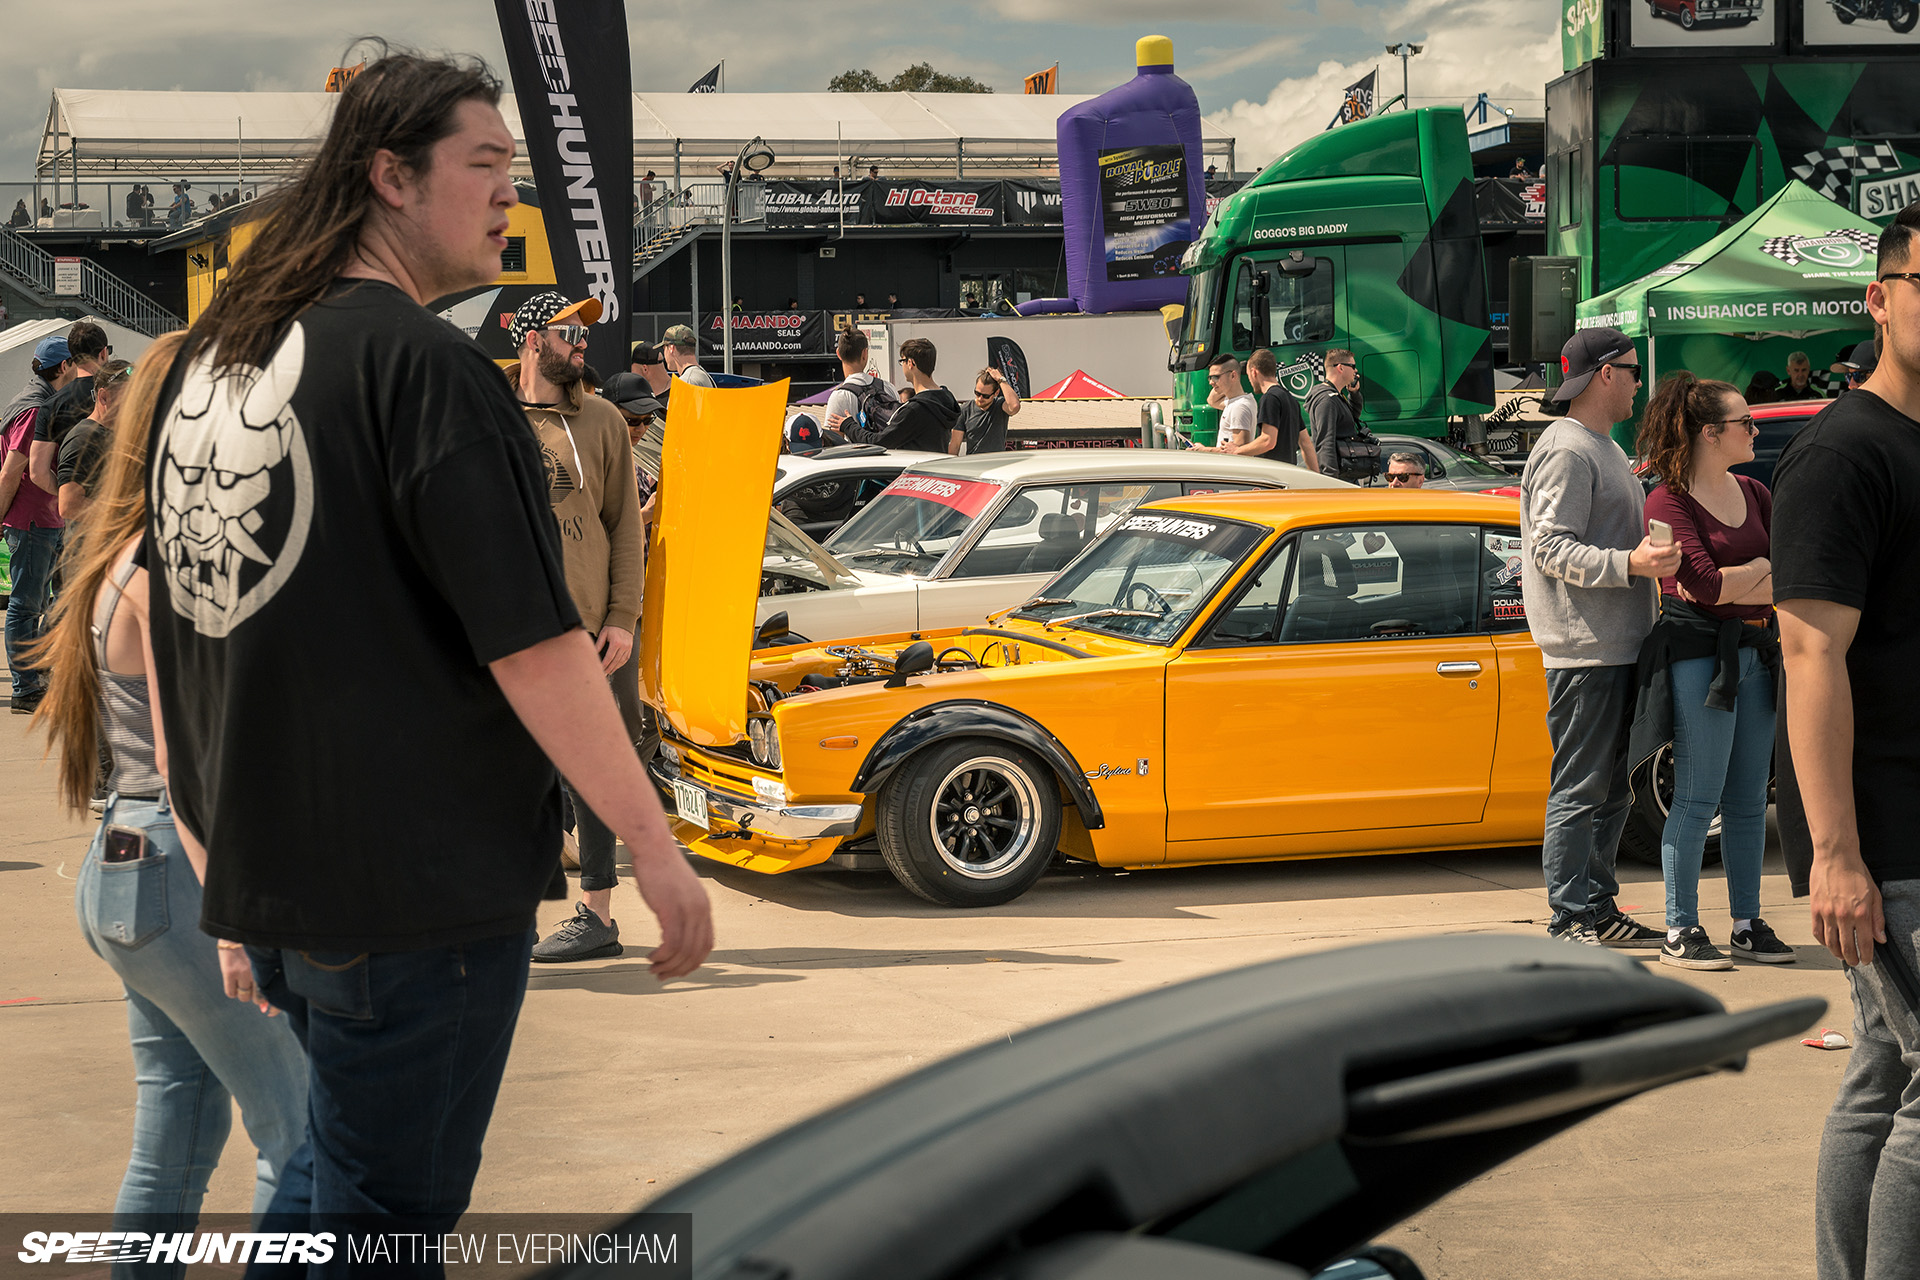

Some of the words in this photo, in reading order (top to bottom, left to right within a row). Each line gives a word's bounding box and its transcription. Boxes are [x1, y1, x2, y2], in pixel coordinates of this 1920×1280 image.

[1106, 160, 1143, 178] ROYAL
[1135, 159, 1181, 183] PURPLE
[816, 189, 861, 205] AUTO
[885, 189, 909, 206] hi
[909, 189, 978, 207] Octane
[1125, 197, 1172, 212] 5W30
[930, 206, 994, 216] DIRECT.com
[1136, 212, 1178, 221] PERFORMANCE
[1254, 227, 1297, 239] GOGGO'S
[1298, 225, 1315, 236] BIG
[1317, 223, 1348, 235] DADDY
[1667, 303, 1768, 321] INSURANCE
[1772, 303, 1808, 317] FOR
[712, 342, 802, 350] ww.AMAANDO.com
[1118, 516, 1217, 540] SPEEDHUNTERS
